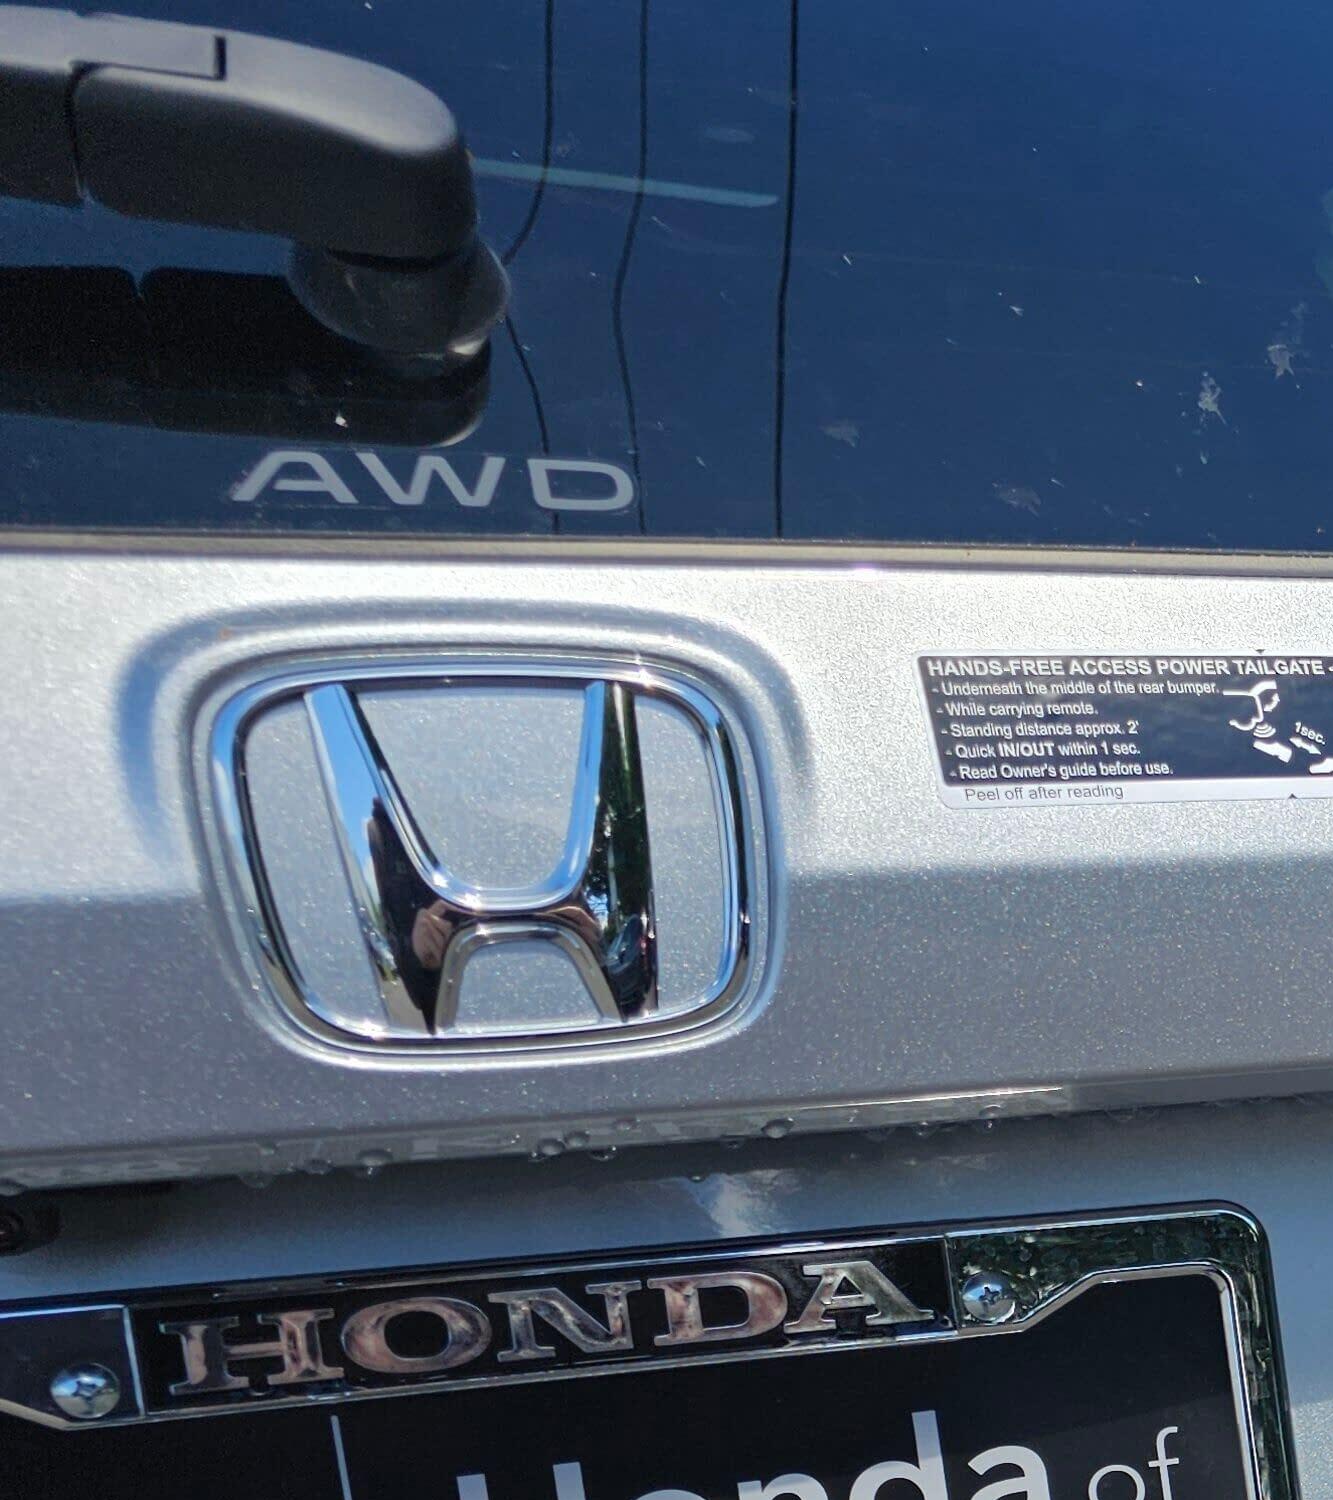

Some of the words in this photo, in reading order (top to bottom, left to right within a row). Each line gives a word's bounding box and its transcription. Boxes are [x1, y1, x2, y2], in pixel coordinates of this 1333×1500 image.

[231, 450, 635, 511] AWD
[927, 659, 1065, 676] HANDS-FREE
[1069, 659, 1152, 675] ACCESS
[1155, 659, 1230, 675] POWER
[1231, 660, 1325, 675] TAILGATE
[941, 681, 1023, 696] Underneath
[1025, 681, 1048, 695] the
[1051, 680, 1095, 695] middle
[1098, 680, 1112, 694] of
[1113, 680, 1136, 694] the
[1138, 682, 1165, 694] rear
[944, 702, 986, 716] While
[989, 702, 1045, 718] carrying
[1047, 702, 1098, 715] remote.
[950, 724, 1013, 739] Standing
[1015, 722, 1072, 736] distance
[1075, 723, 1125, 738] approx.
[955, 743, 997, 759] Quick
[998, 743, 1055, 757] IN/OUT
[1058, 742, 1098, 756] within
[1100, 741, 1109, 755] 1
[1112, 744, 1141, 755] sec.
[959, 765, 997, 779] Read
[1001, 763, 1057, 779] Owner's
[1059, 763, 1097, 780] guide
[1098, 761, 1142, 776] before
[1145, 763, 1173, 775] use.
[964, 788, 1000, 802] Peel
[1004, 787, 1024, 800] off
[1029, 787, 1062, 800] after
[1067, 786, 1124, 799] reading
[157, 1260, 936, 1396] HONDA
